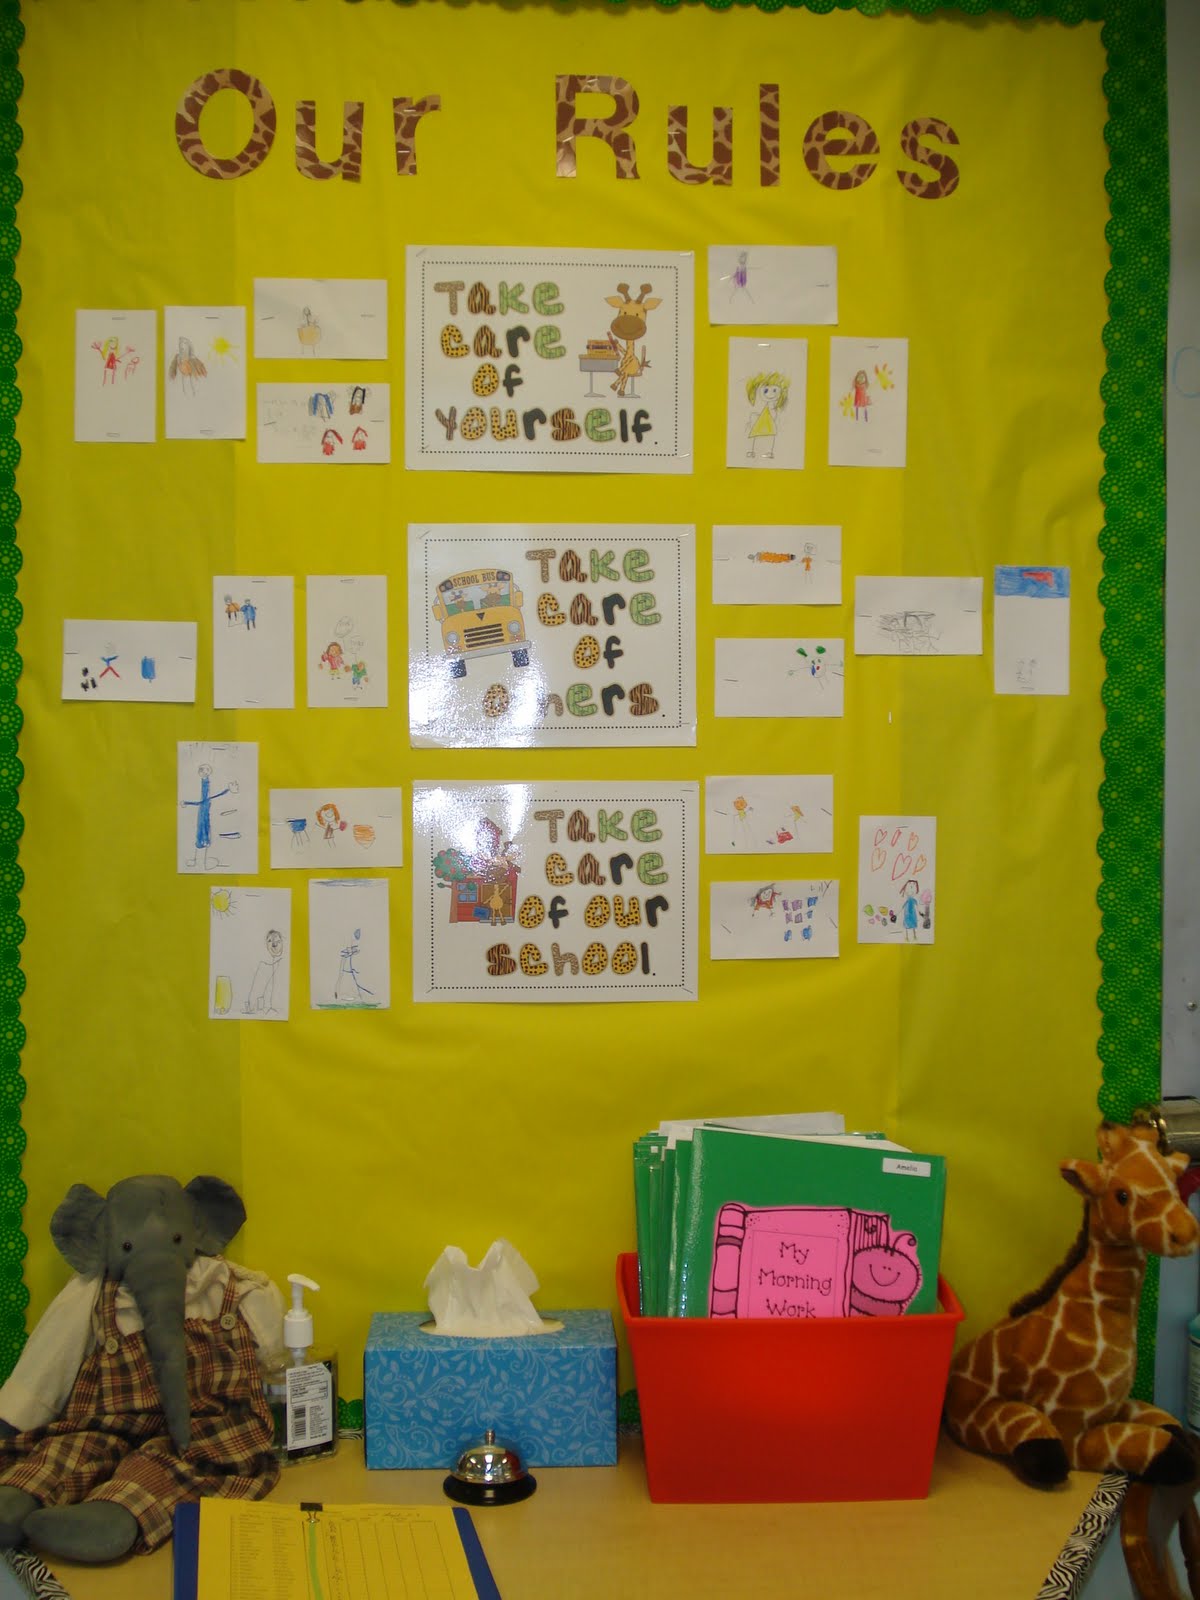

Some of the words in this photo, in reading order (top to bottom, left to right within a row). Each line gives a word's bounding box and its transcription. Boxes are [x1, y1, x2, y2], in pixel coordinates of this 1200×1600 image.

[175, 68, 441, 183] Our
[556, 75, 960, 199] Rules
[434, 280, 564, 316] Take
[452, 574, 480, 588] SCHOOL
[482, 571, 496, 582] BUS
[525, 549, 655, 583] Take
[534, 809, 662, 843] Take
[518, 895, 569, 929] of
[779, 1242, 810, 1266] My
[758, 1268, 832, 1297] Morning
[766, 1299, 817, 1319] Work
